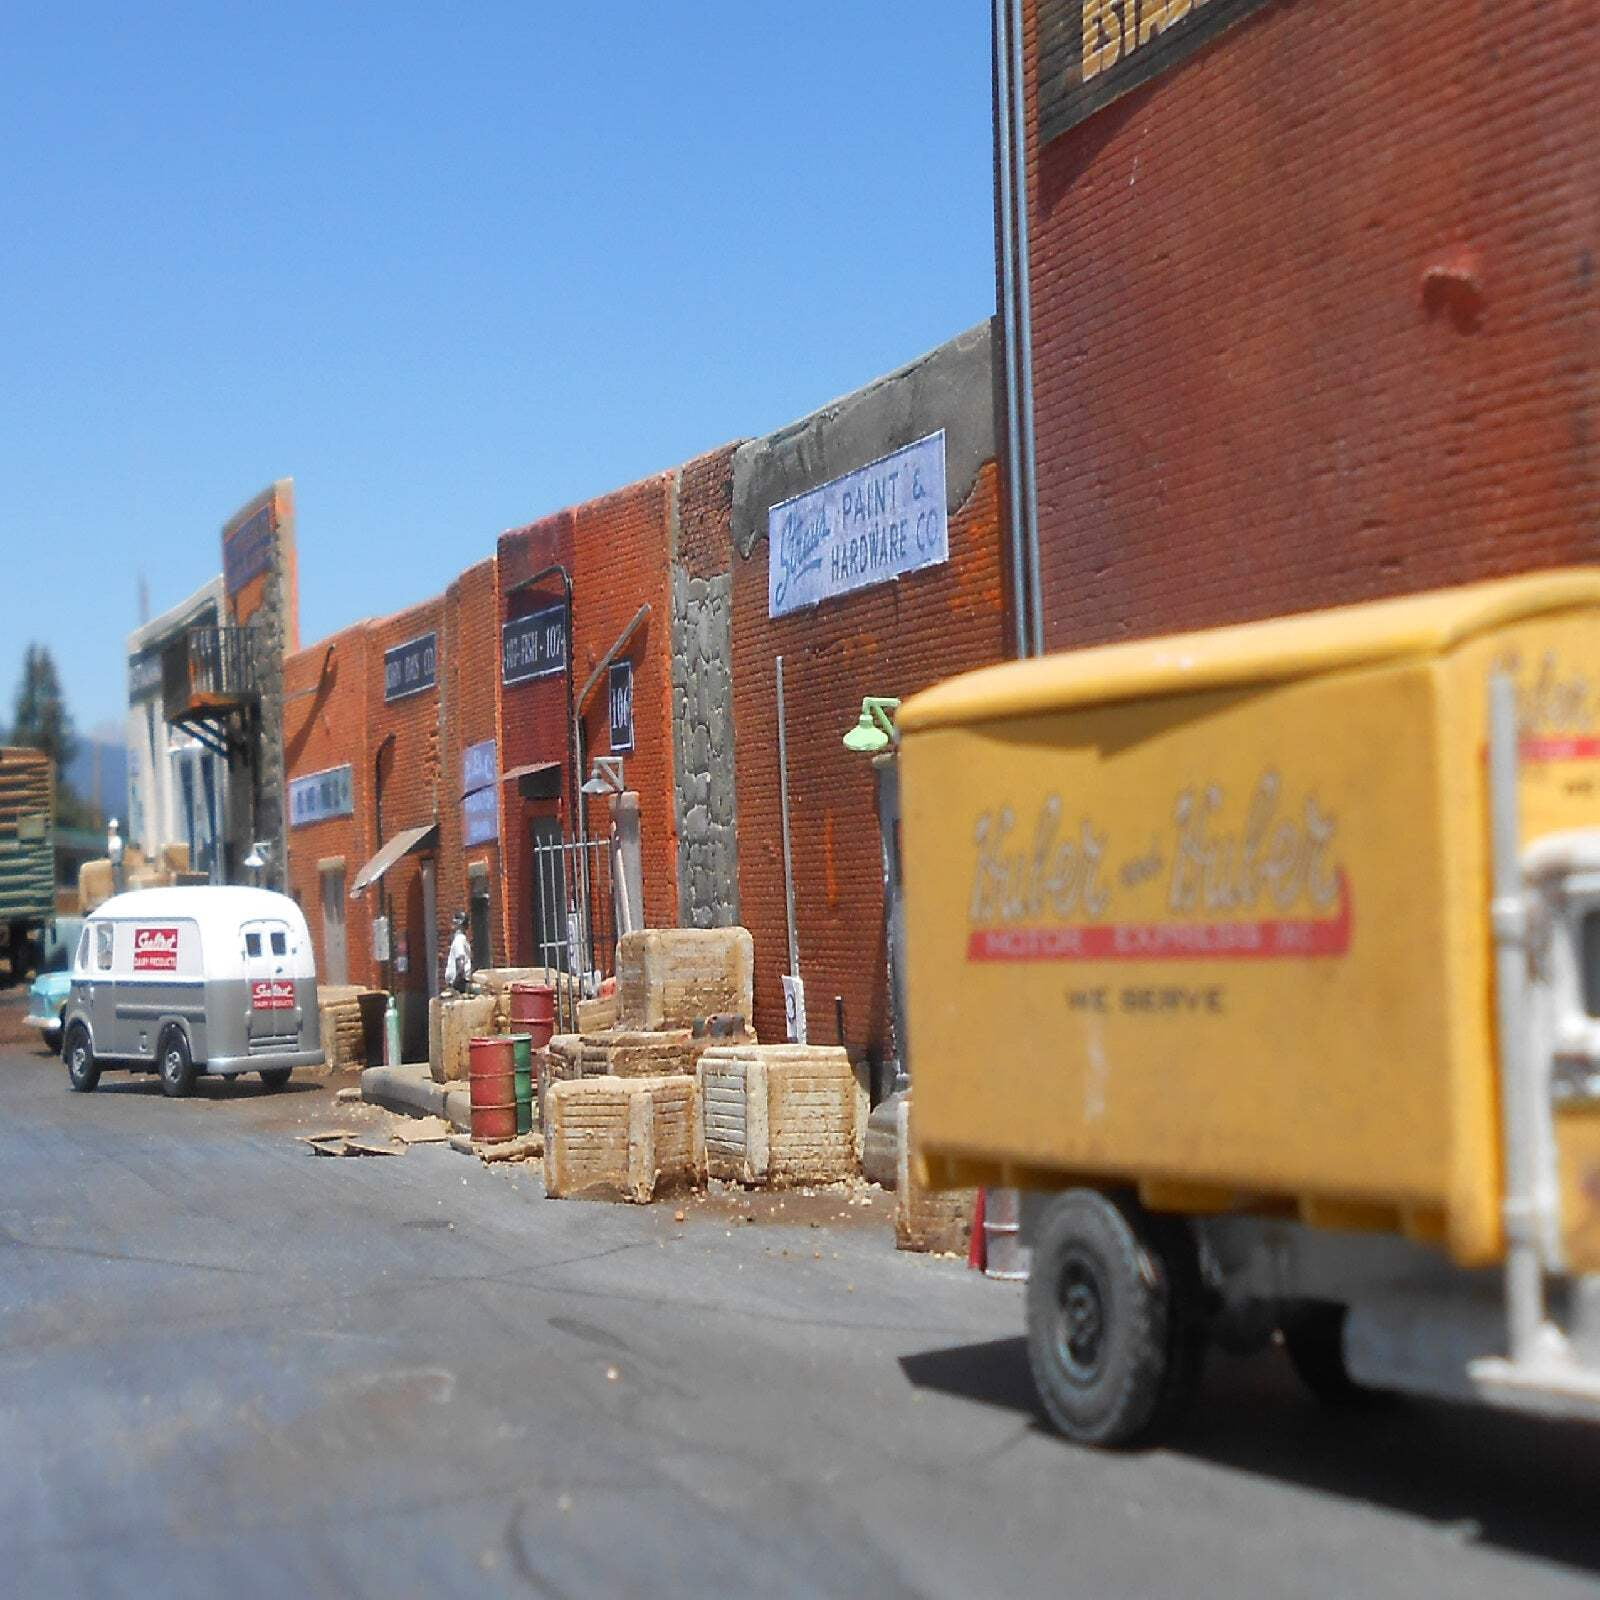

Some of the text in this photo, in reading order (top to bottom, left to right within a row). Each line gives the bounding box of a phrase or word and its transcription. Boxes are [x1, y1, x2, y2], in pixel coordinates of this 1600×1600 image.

[842, 471, 899, 529] PAINT
[912, 466, 926, 500] &
[831, 517, 908, 583] HARDWARE
[984, 928, 1082, 954] MOTOR
[1113, 923, 1262, 951] EXPRESS
[1067, 986, 1222, 1013] WE SERVE
